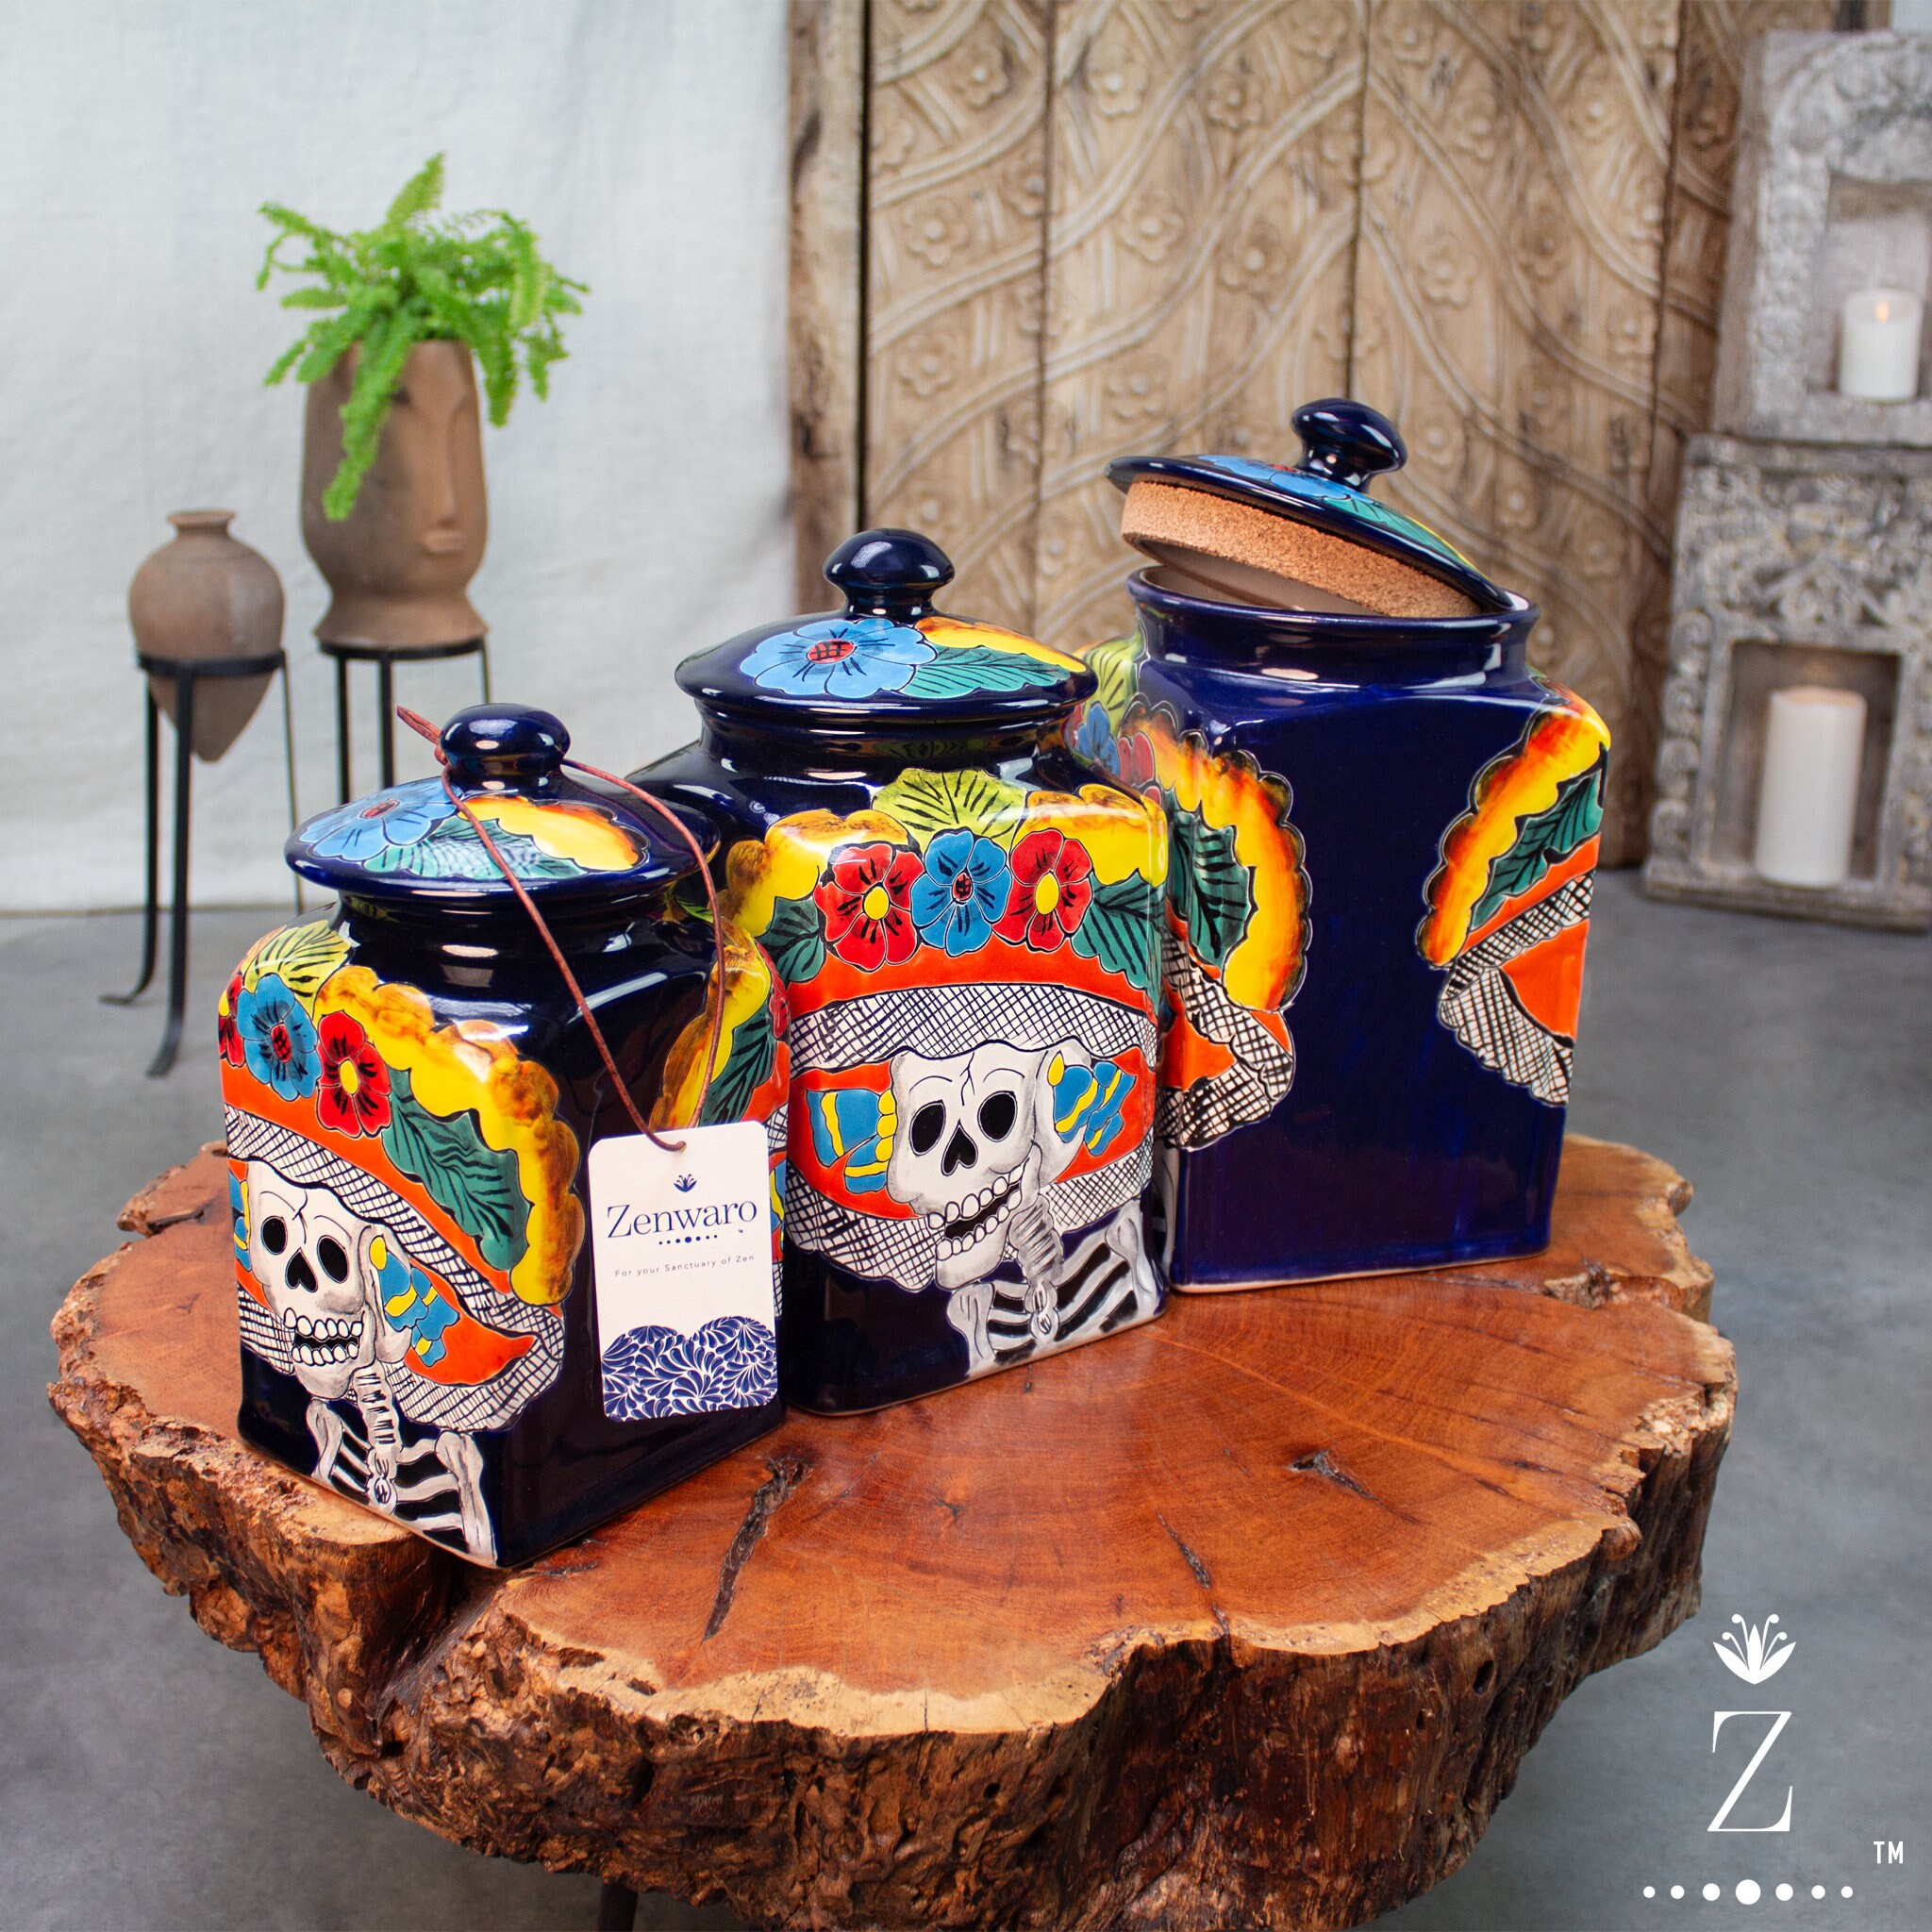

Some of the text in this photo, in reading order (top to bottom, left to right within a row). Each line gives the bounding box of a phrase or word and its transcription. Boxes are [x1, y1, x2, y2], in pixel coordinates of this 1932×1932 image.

[607, 1199, 758, 1239] Zenwaro
[637, 1267, 659, 1275] your
[664, 1259, 716, 1272] Sanctuary
[721, 1256, 731, 1265] of
[736, 1255, 755, 1263] Zen
